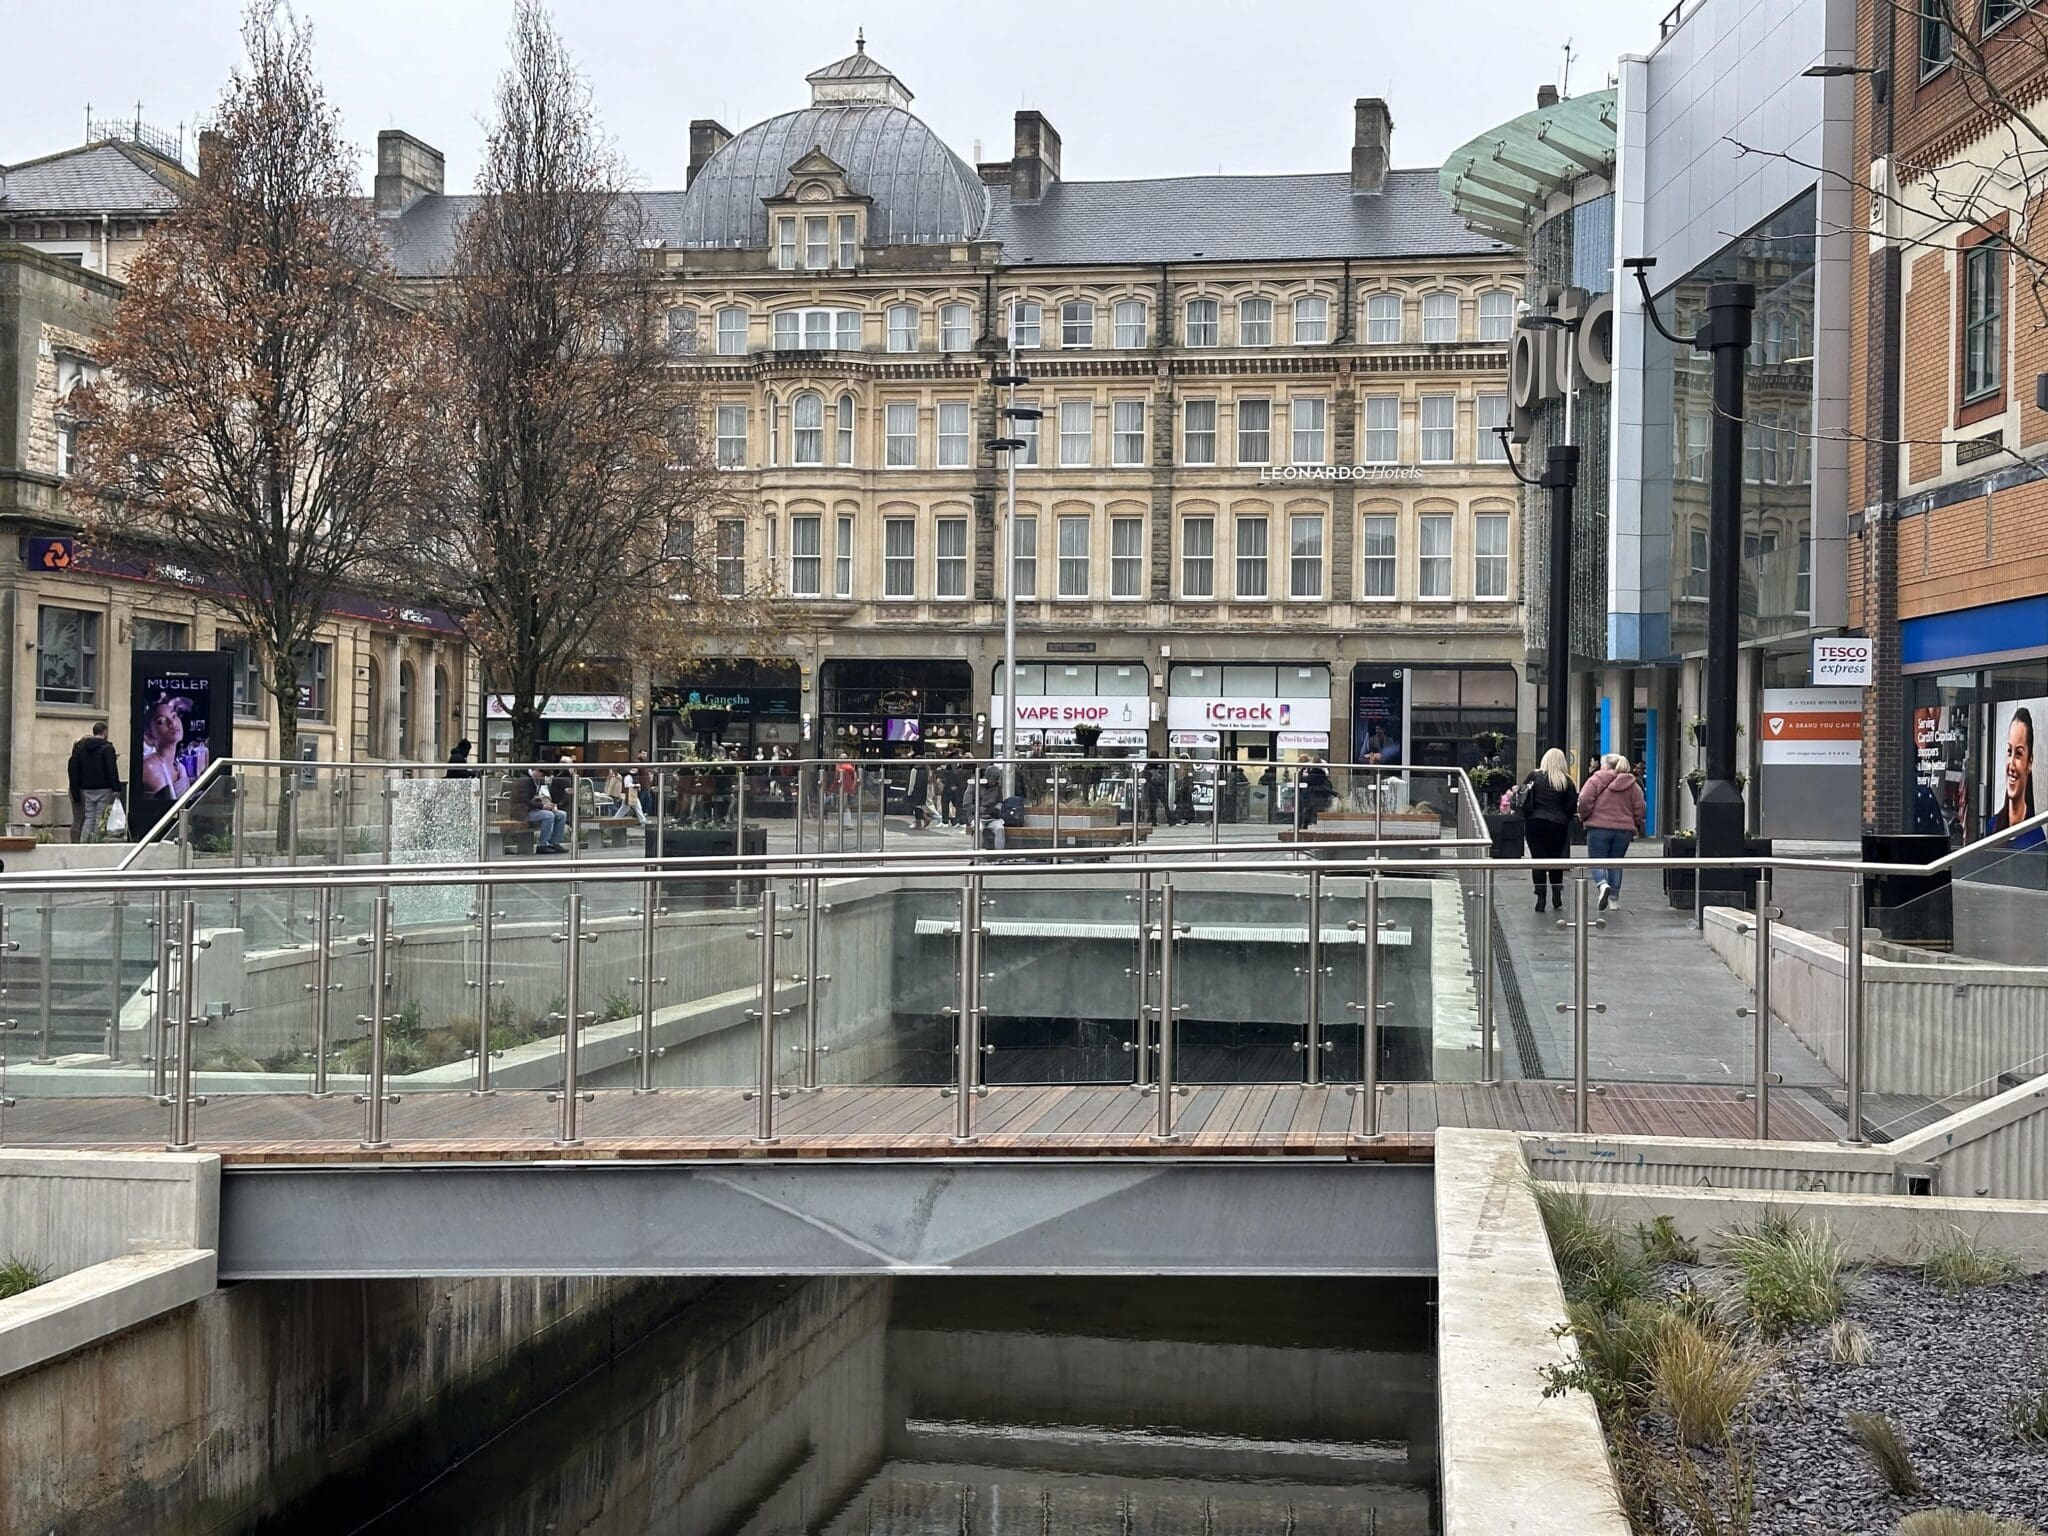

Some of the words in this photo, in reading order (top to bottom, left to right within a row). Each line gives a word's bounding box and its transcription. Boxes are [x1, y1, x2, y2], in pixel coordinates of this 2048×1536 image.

[1261, 466, 1366, 480] LEONARDO
[1367, 464, 1424, 480] Hotels
[1818, 646, 1868, 658] TESCO
[1820, 663, 1865, 676] express
[147, 679, 209, 690] MUGLER
[705, 693, 750, 705] Ganesha
[1017, 707, 1059, 720] VAPE
[1063, 707, 1109, 720] SHOP
[1206, 703, 1272, 720] iCrack
